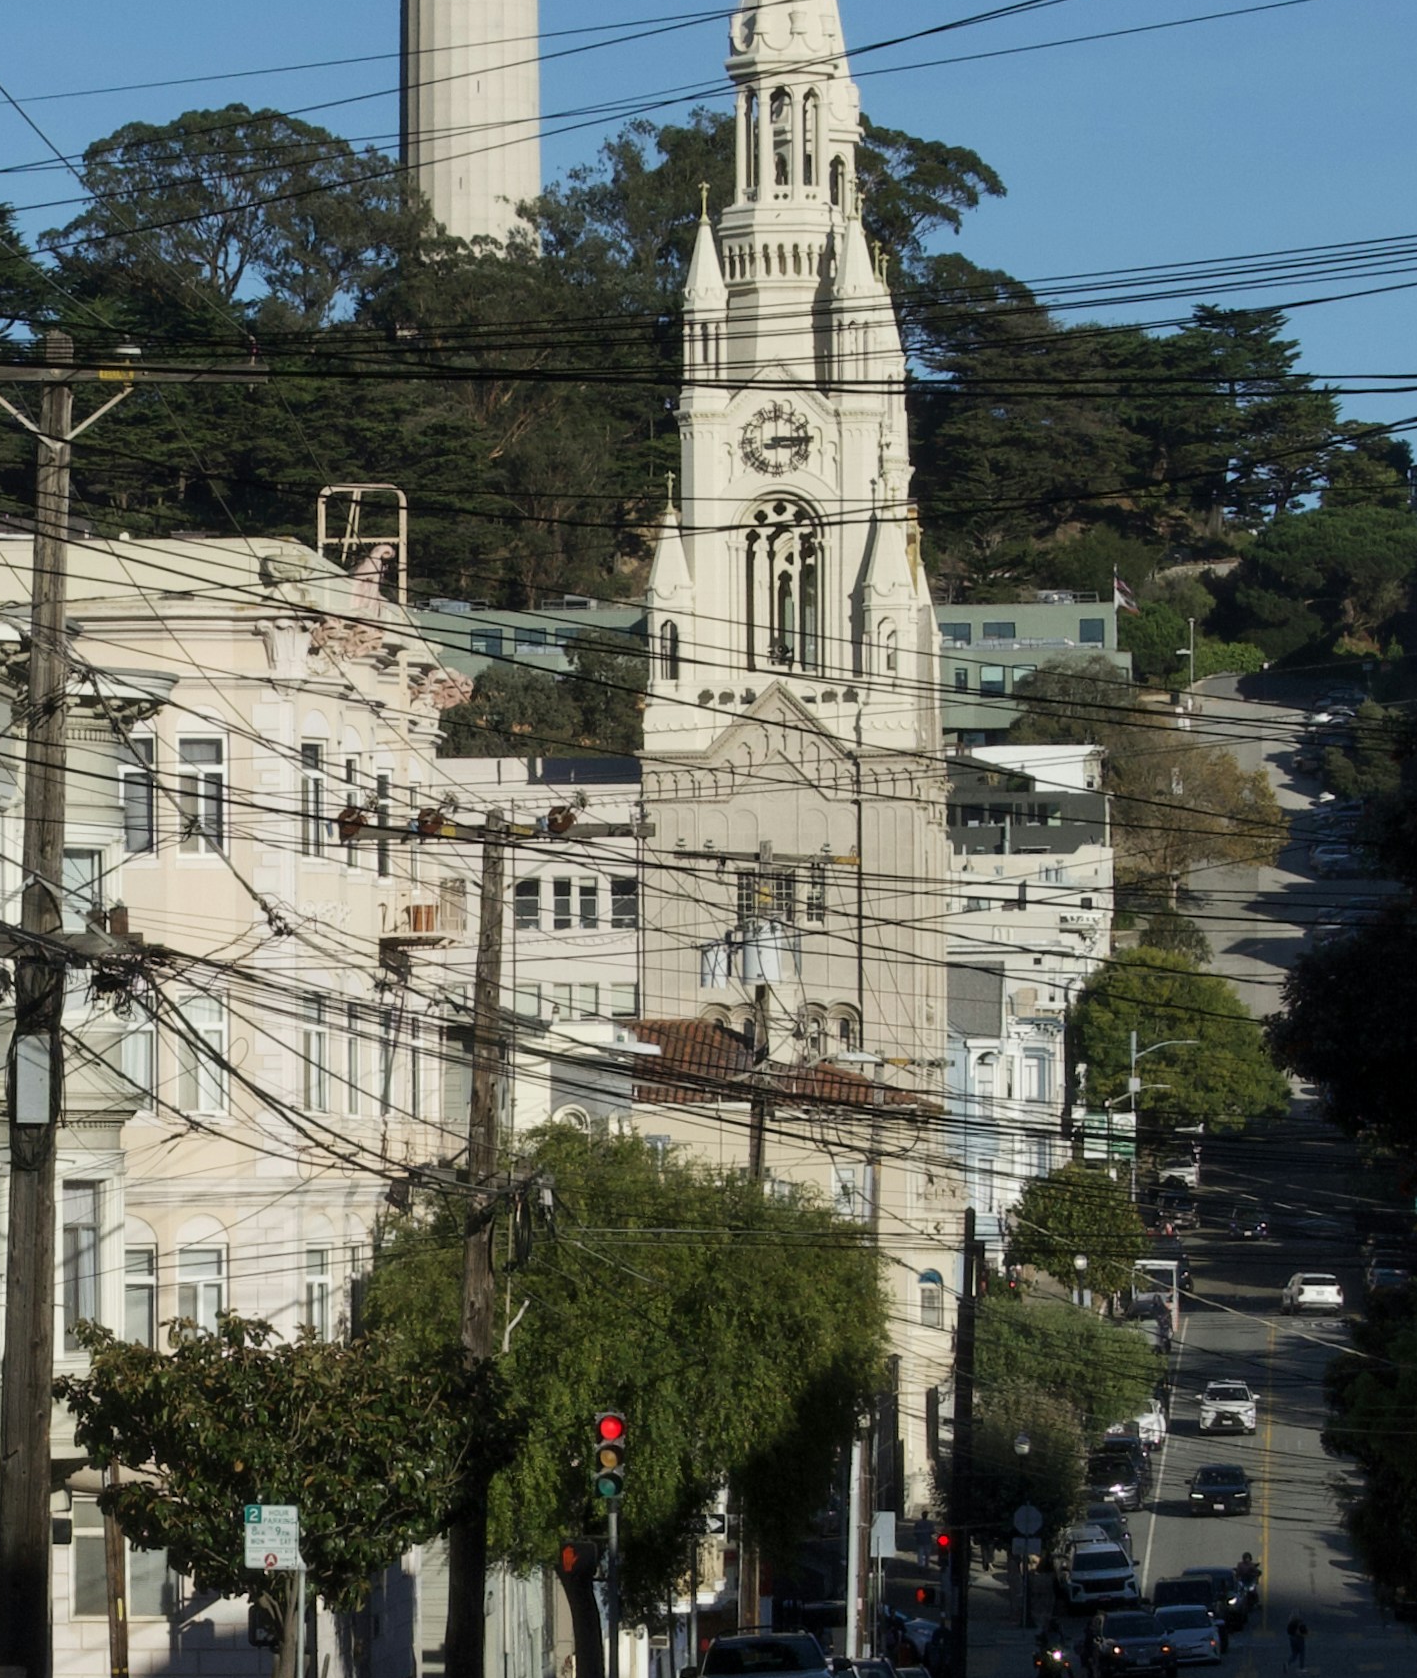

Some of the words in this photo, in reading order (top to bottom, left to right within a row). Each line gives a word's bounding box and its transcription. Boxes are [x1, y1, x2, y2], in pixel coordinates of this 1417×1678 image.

[249, 1508, 259, 1522] 2
[268, 1509, 289, 1517] HOUR
[266, 1554, 276, 1565] A
